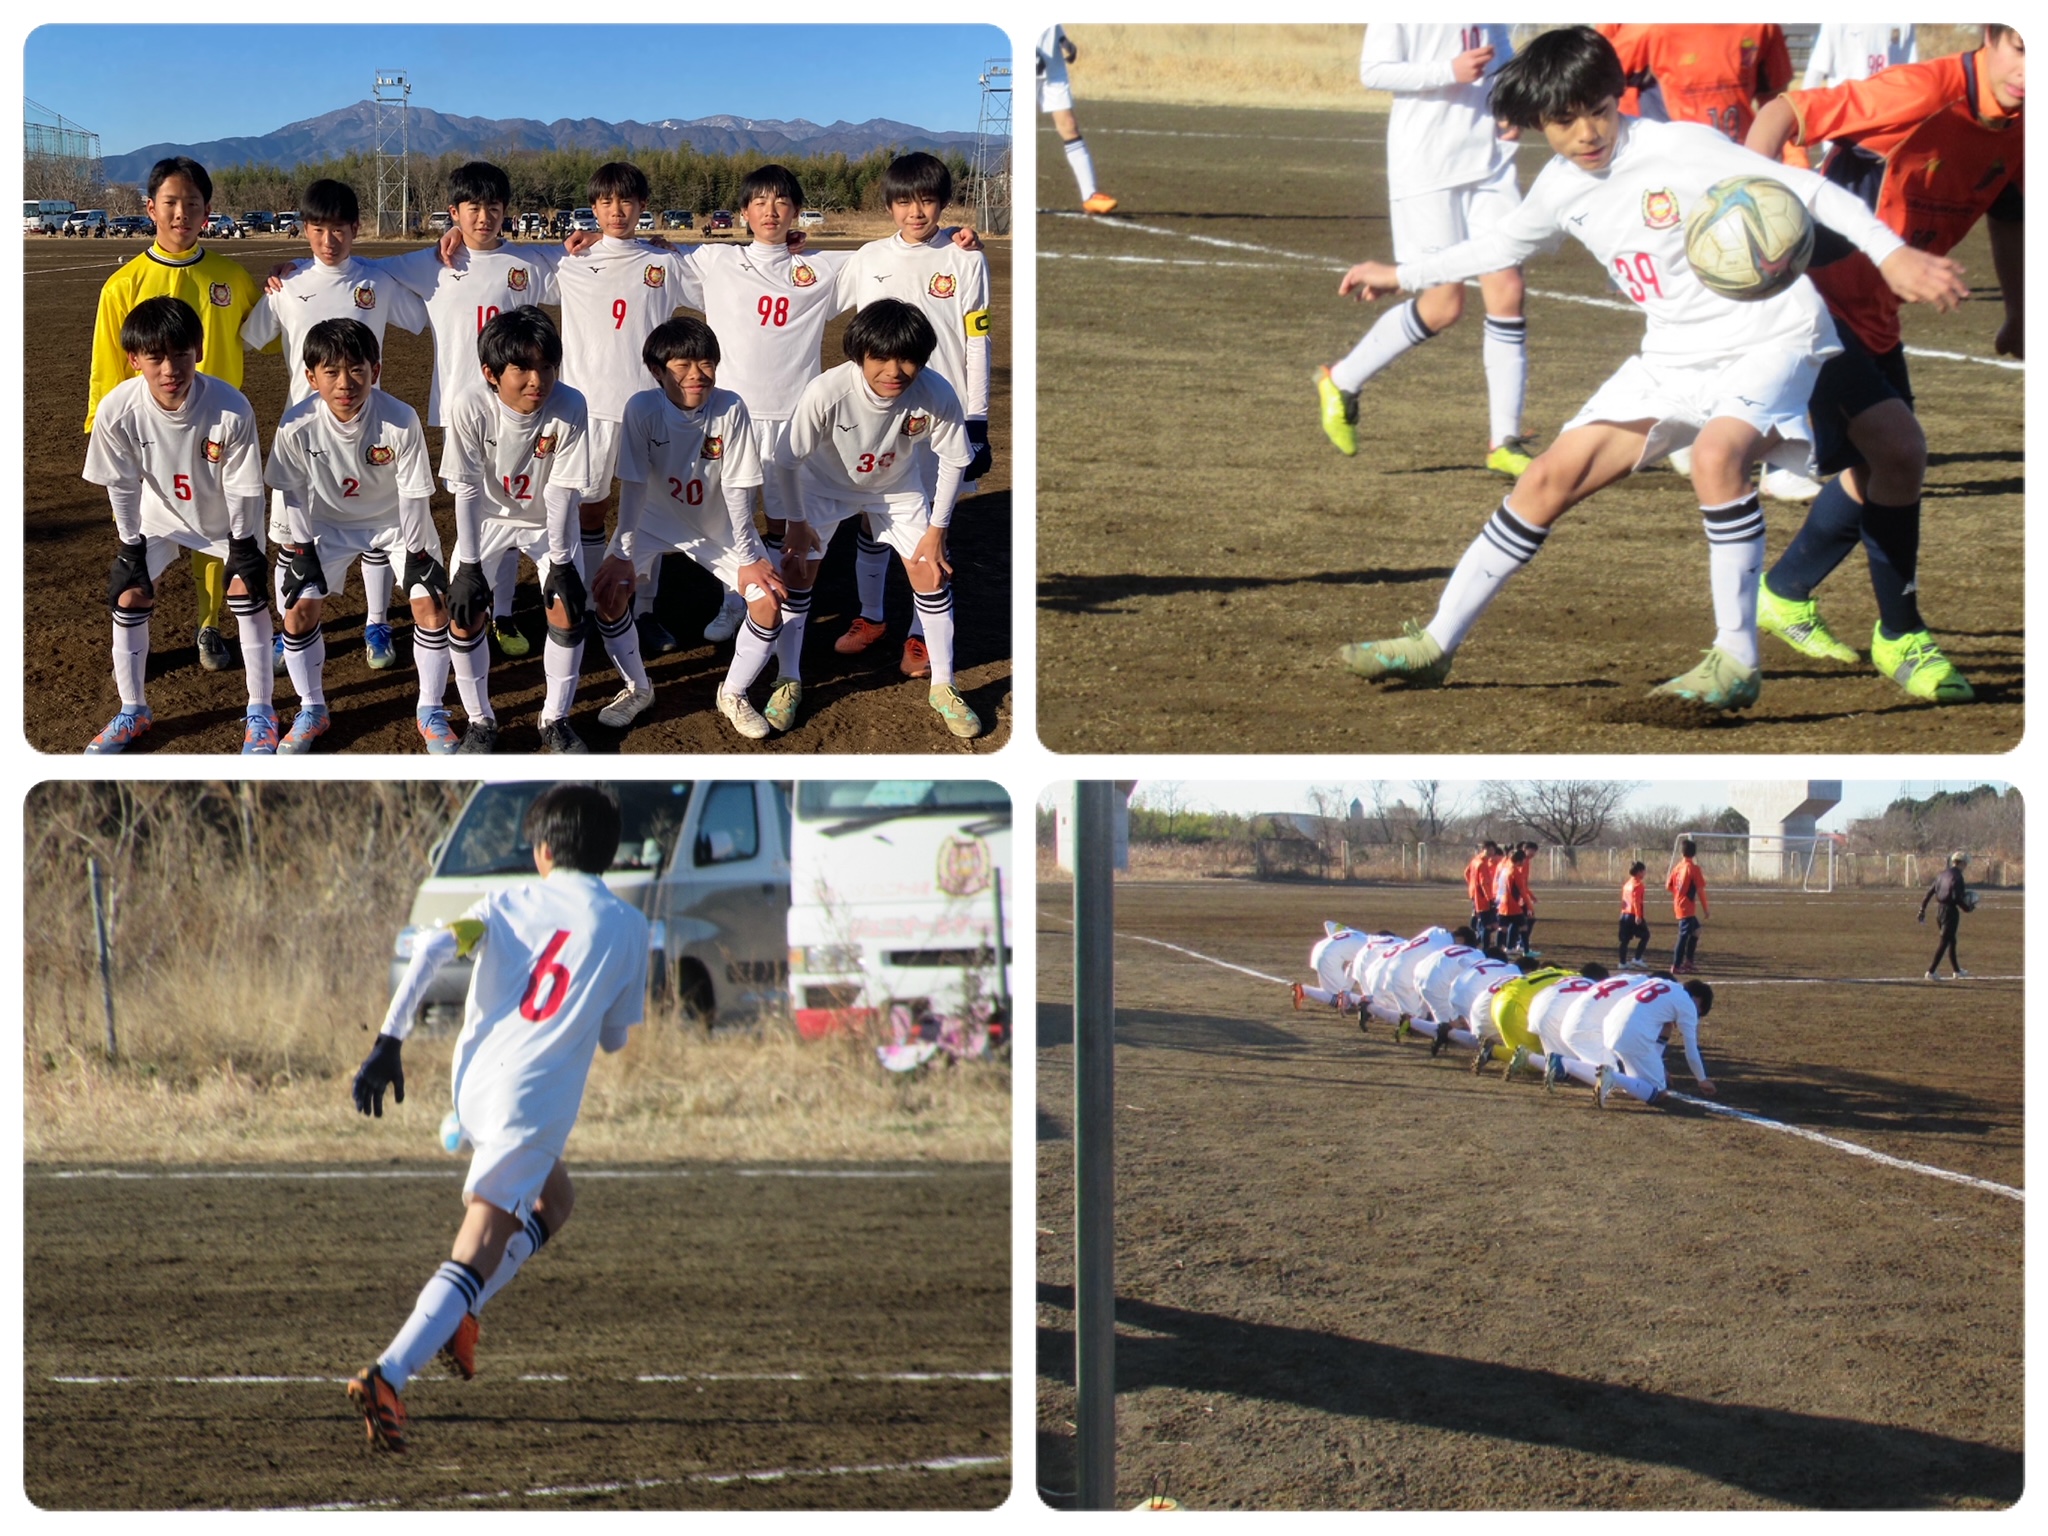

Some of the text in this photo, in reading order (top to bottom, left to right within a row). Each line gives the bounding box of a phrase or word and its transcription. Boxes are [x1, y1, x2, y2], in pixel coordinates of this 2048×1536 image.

[1615, 252, 1662, 302] 39
[612, 299, 626, 331] 9
[757, 295, 790, 327] 98
[975, 315, 989, 331] C
[173, 474, 192, 501] 5
[343, 478, 360, 497] 2
[503, 474, 532, 500] 12
[668, 477, 703, 506] 20
[519, 929, 572, 1022] 6
[1593, 980, 1629, 1001] 4
